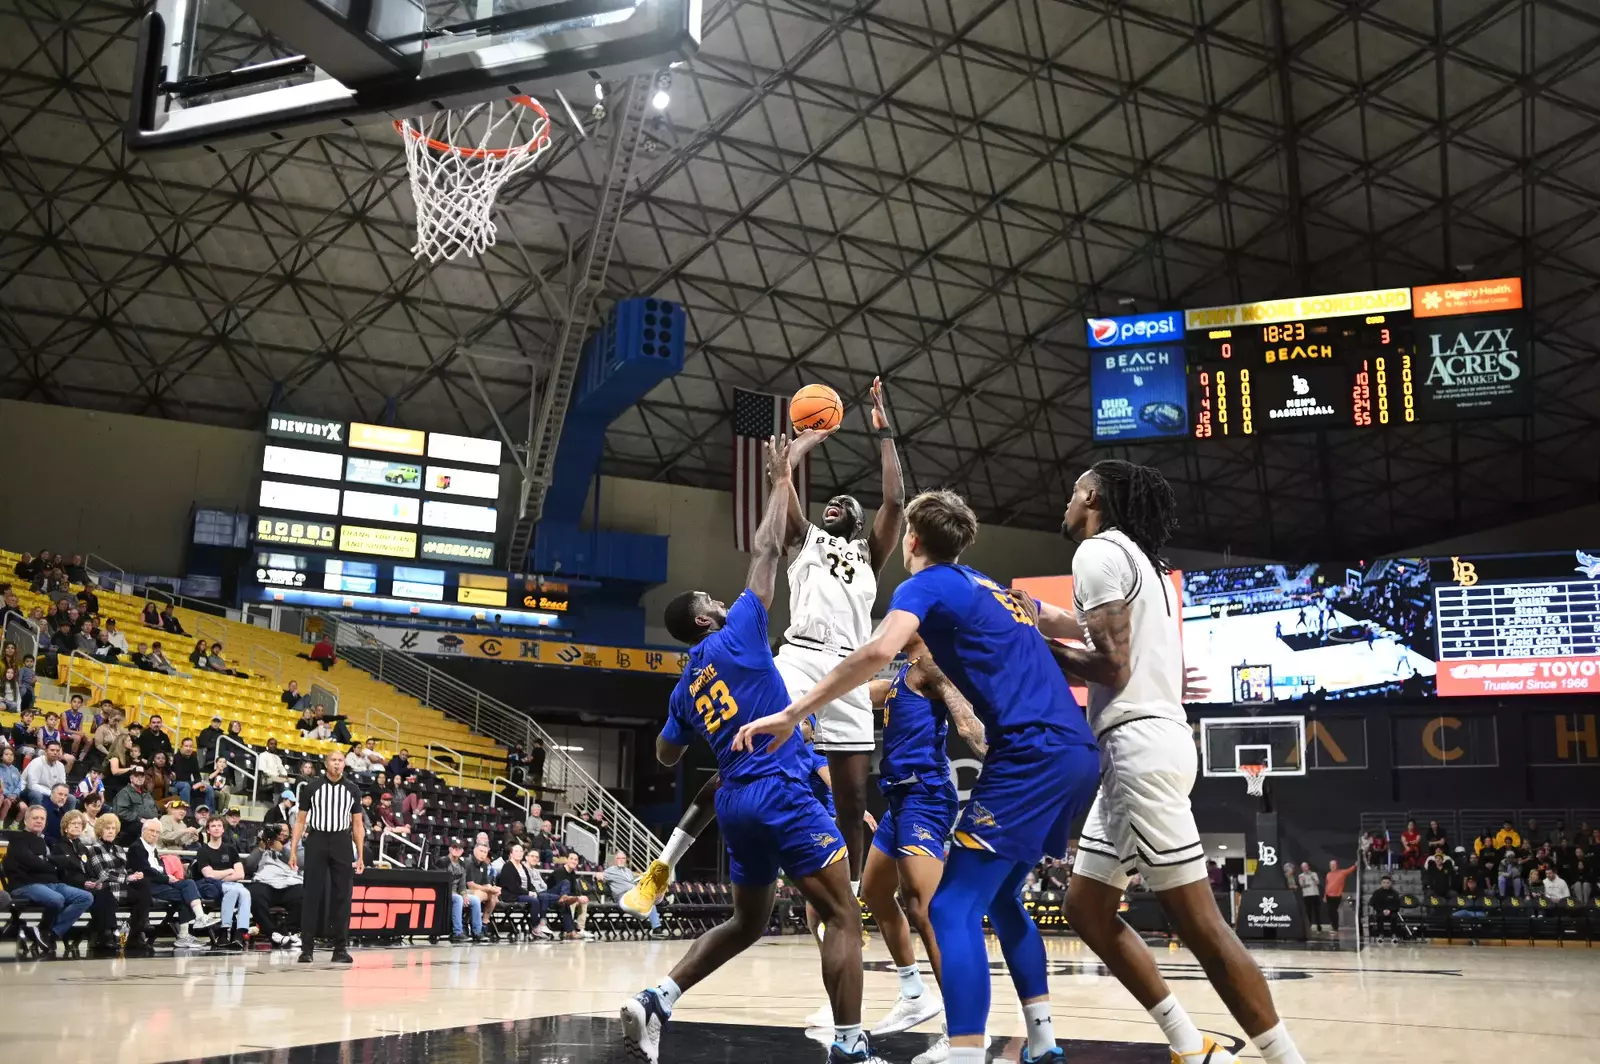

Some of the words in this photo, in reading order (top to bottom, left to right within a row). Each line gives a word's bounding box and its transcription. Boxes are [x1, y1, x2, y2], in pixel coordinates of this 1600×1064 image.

[1121, 316, 1175, 340] pepsi
[1263, 323, 1305, 343] 18:23
[1380, 329, 1390, 344] 3
[1429, 328, 1514, 357] LAZY
[1221, 343, 1231, 358] 0
[1265, 345, 1332, 364] BEACH
[1105, 352, 1169, 369] BEACH
[1424, 350, 1520, 386] ACRES
[1457, 374, 1499, 386] MARKET
[826, 552, 855, 584] 23
[1504, 586, 1558, 596] Rebounds
[1513, 597, 1550, 605] Assists
[1514, 606, 1548, 615] Steals
[1506, 637, 1533, 647] Field
[1536, 636, 1561, 646] Goal
[1483, 680, 1524, 691] Trusted
[1526, 679, 1557, 690] Since
[1561, 678, 1588, 689] 1966
[695, 680, 738, 734] 23
[349, 886, 436, 929] ESPN
[1248, 914, 1270, 922] Dignity
